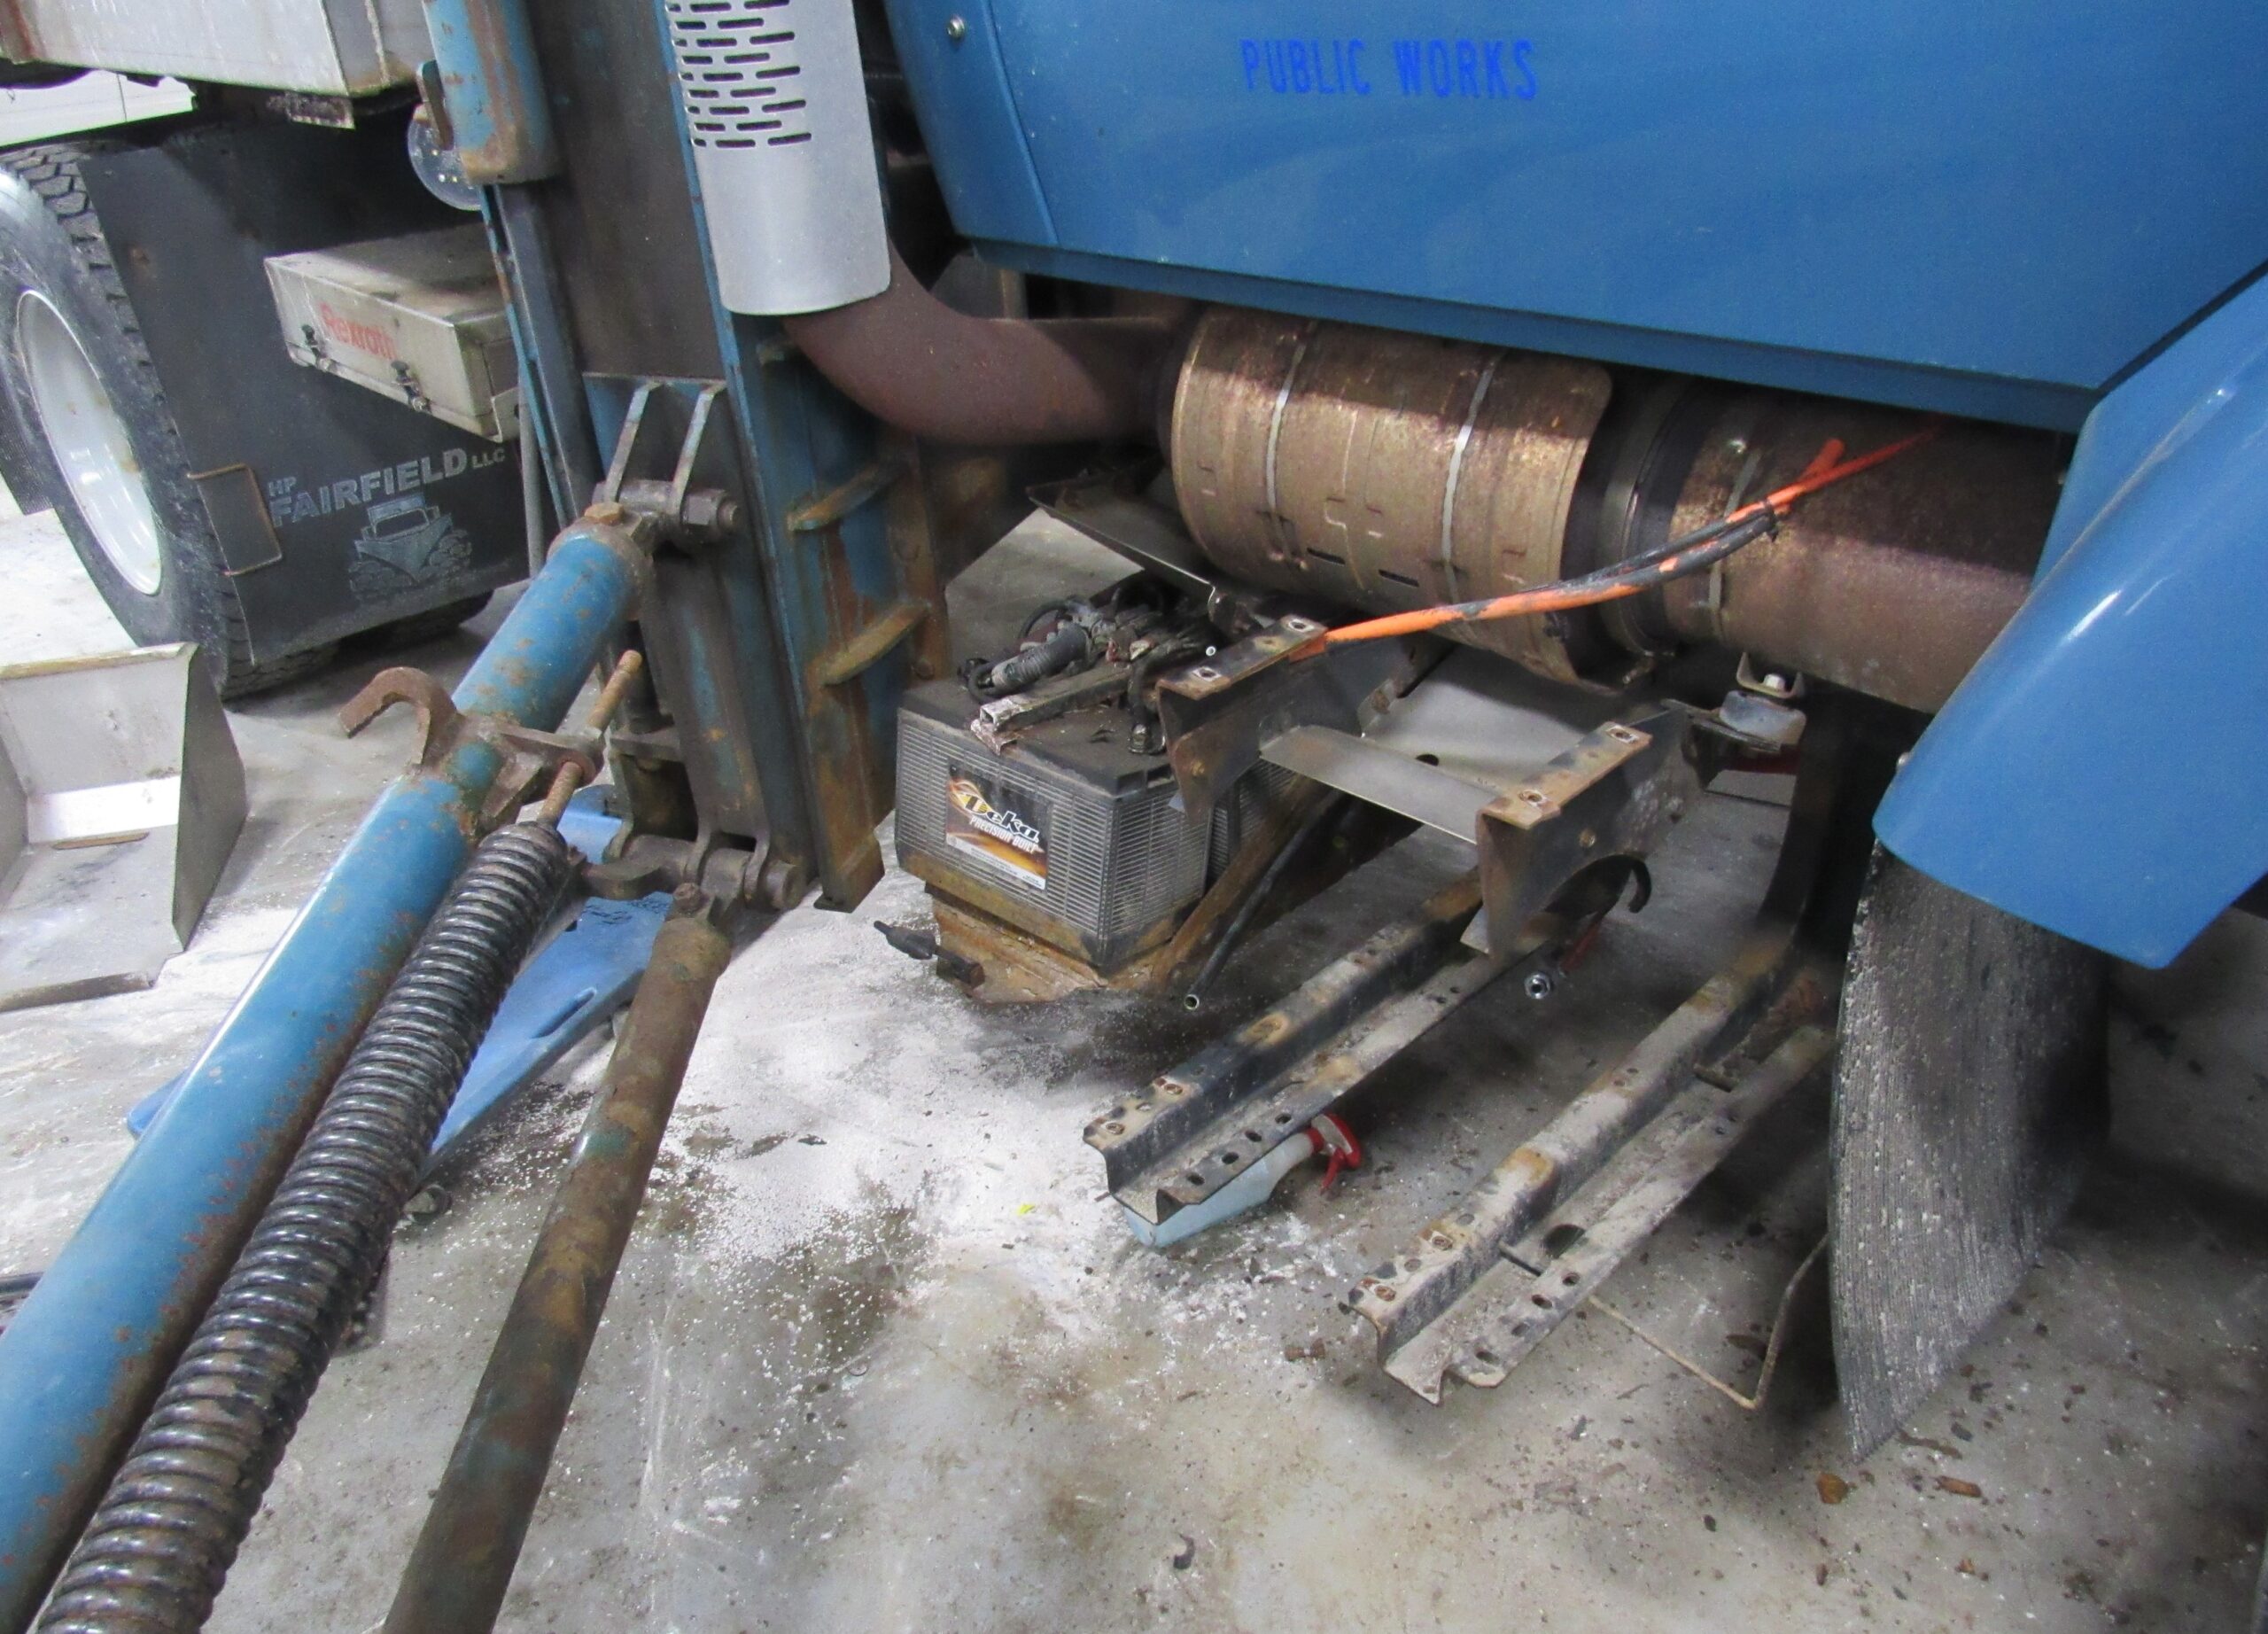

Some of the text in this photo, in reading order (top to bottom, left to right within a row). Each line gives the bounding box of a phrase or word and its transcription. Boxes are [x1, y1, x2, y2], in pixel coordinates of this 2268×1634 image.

[1241, 38, 1537, 101] PUBLIC WORKS
[320, 301, 398, 362] Rexroth
[268, 476, 297, 497] HP
[269, 447, 506, 528] FAIRFIELD LLC
[956, 792, 1040, 841] Deka
[968, 815, 1045, 855] PRECISION BUILT
